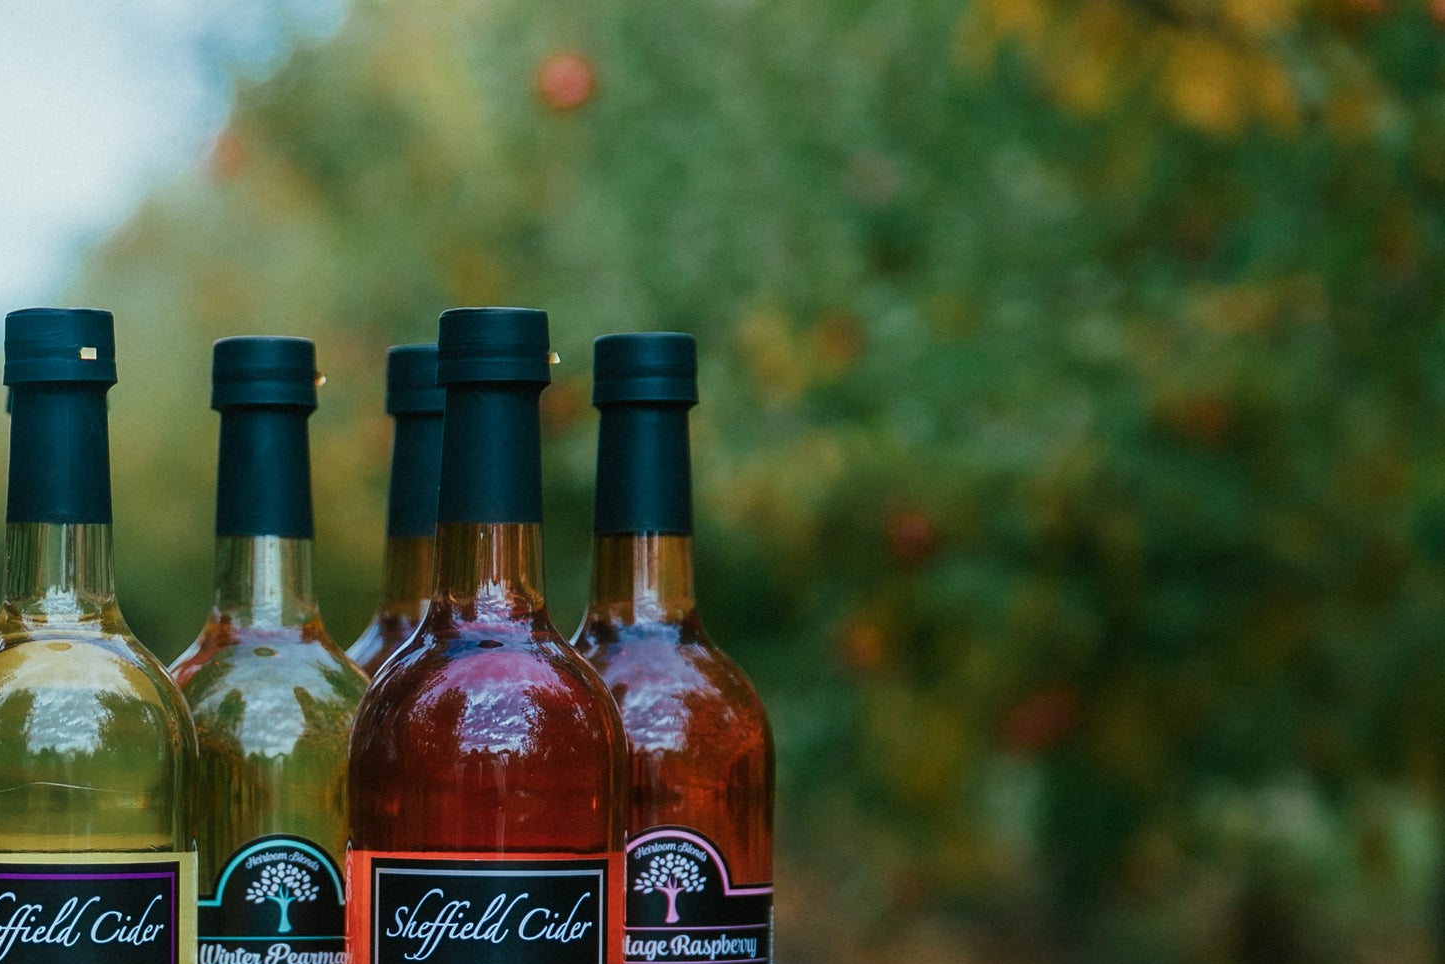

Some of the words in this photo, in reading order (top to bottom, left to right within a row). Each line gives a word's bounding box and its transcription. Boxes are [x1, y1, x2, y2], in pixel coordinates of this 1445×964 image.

[245, 852, 287, 869] Heirloom
[288, 852, 319, 871] Blends
[634, 842, 676, 859] Heirloom
[677, 842, 707, 862] Blends
[91, 894, 163, 945] Cider
[386, 888, 529, 961] Sheffield
[518, 892, 592, 943] Cider
[670, 933, 757, 960] Raspberry
